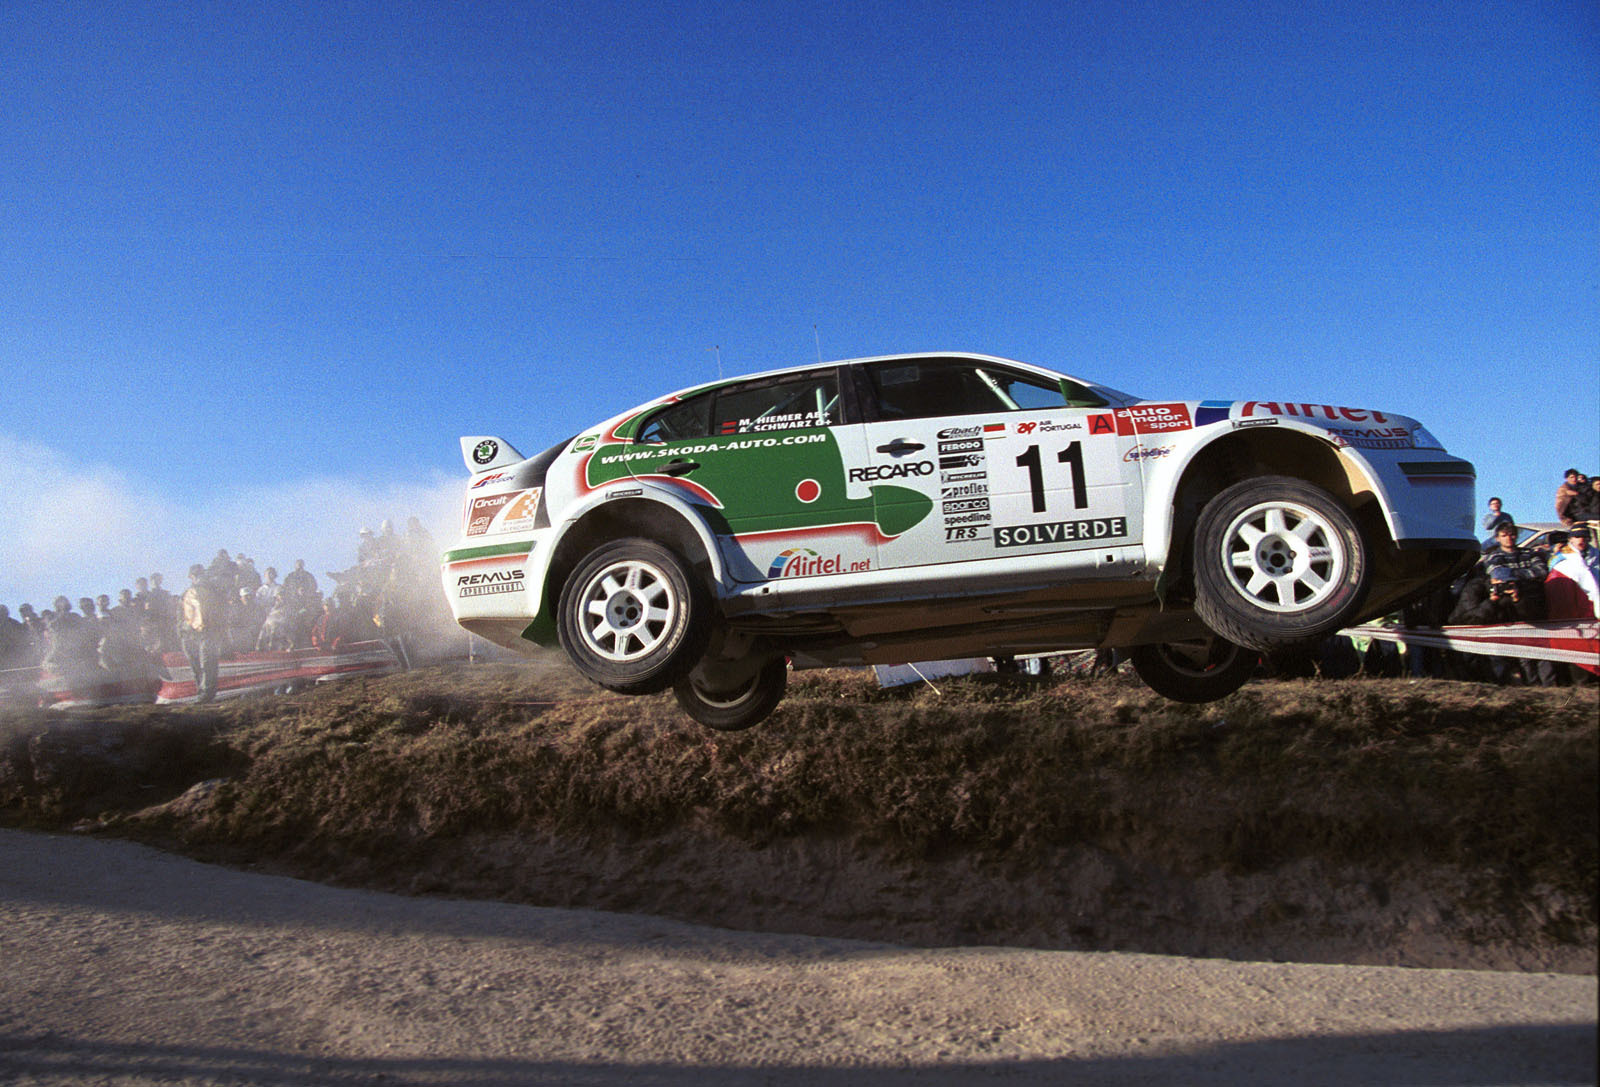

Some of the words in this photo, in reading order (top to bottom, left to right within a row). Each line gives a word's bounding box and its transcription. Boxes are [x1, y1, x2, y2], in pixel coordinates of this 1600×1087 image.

[757, 413, 802, 424] HIEMER
[1117, 408, 1171, 418] auto
[1131, 414, 1182, 423] motor
[754, 420, 811, 432] SCHWARZ
[1039, 423, 1082, 432] PORTUGAL
[1093, 415, 1113, 434] A
[1150, 420, 1190, 430] sport
[937, 425, 981, 440] Eibach
[1328, 427, 1409, 439] REMUS
[941, 441, 981, 452] FERODO
[849, 460, 935, 483] RECARO
[1016, 441, 1088, 513] 11
[953, 483, 988, 498] proflex
[475, 496, 508, 508] Circuit
[944, 500, 988, 511] sparco
[944, 513, 992, 526] speedline
[945, 527, 978, 540] TRS
[999, 519, 1123, 545] SOLVERDE
[457, 569, 525, 586] REMUS
